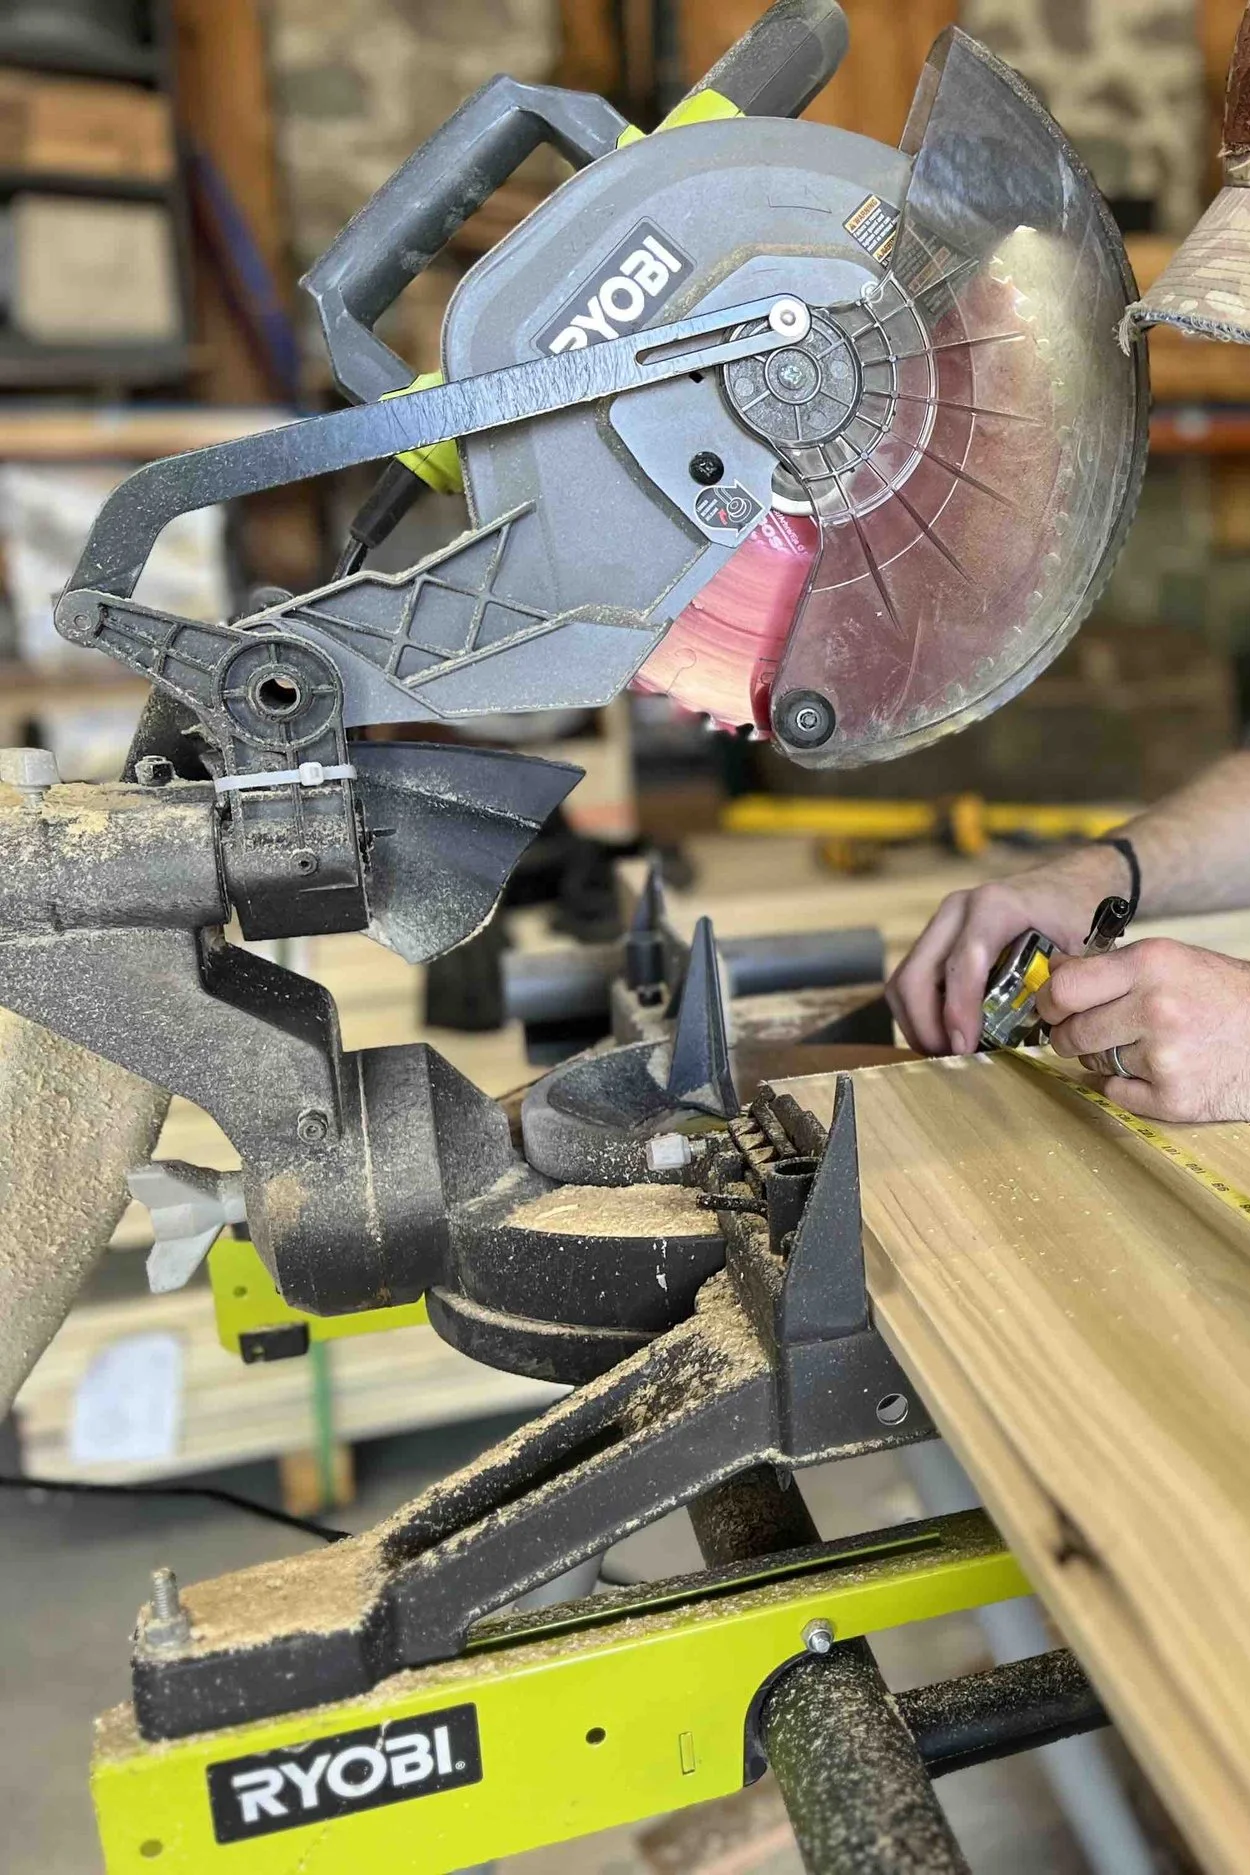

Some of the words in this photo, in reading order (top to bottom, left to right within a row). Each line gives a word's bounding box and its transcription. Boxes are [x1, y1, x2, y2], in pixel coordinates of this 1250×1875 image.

[1186, 1162, 1206, 1174] 100
[1212, 1182, 1230, 1192] 99
[231, 1725, 453, 1823] RYOBI
